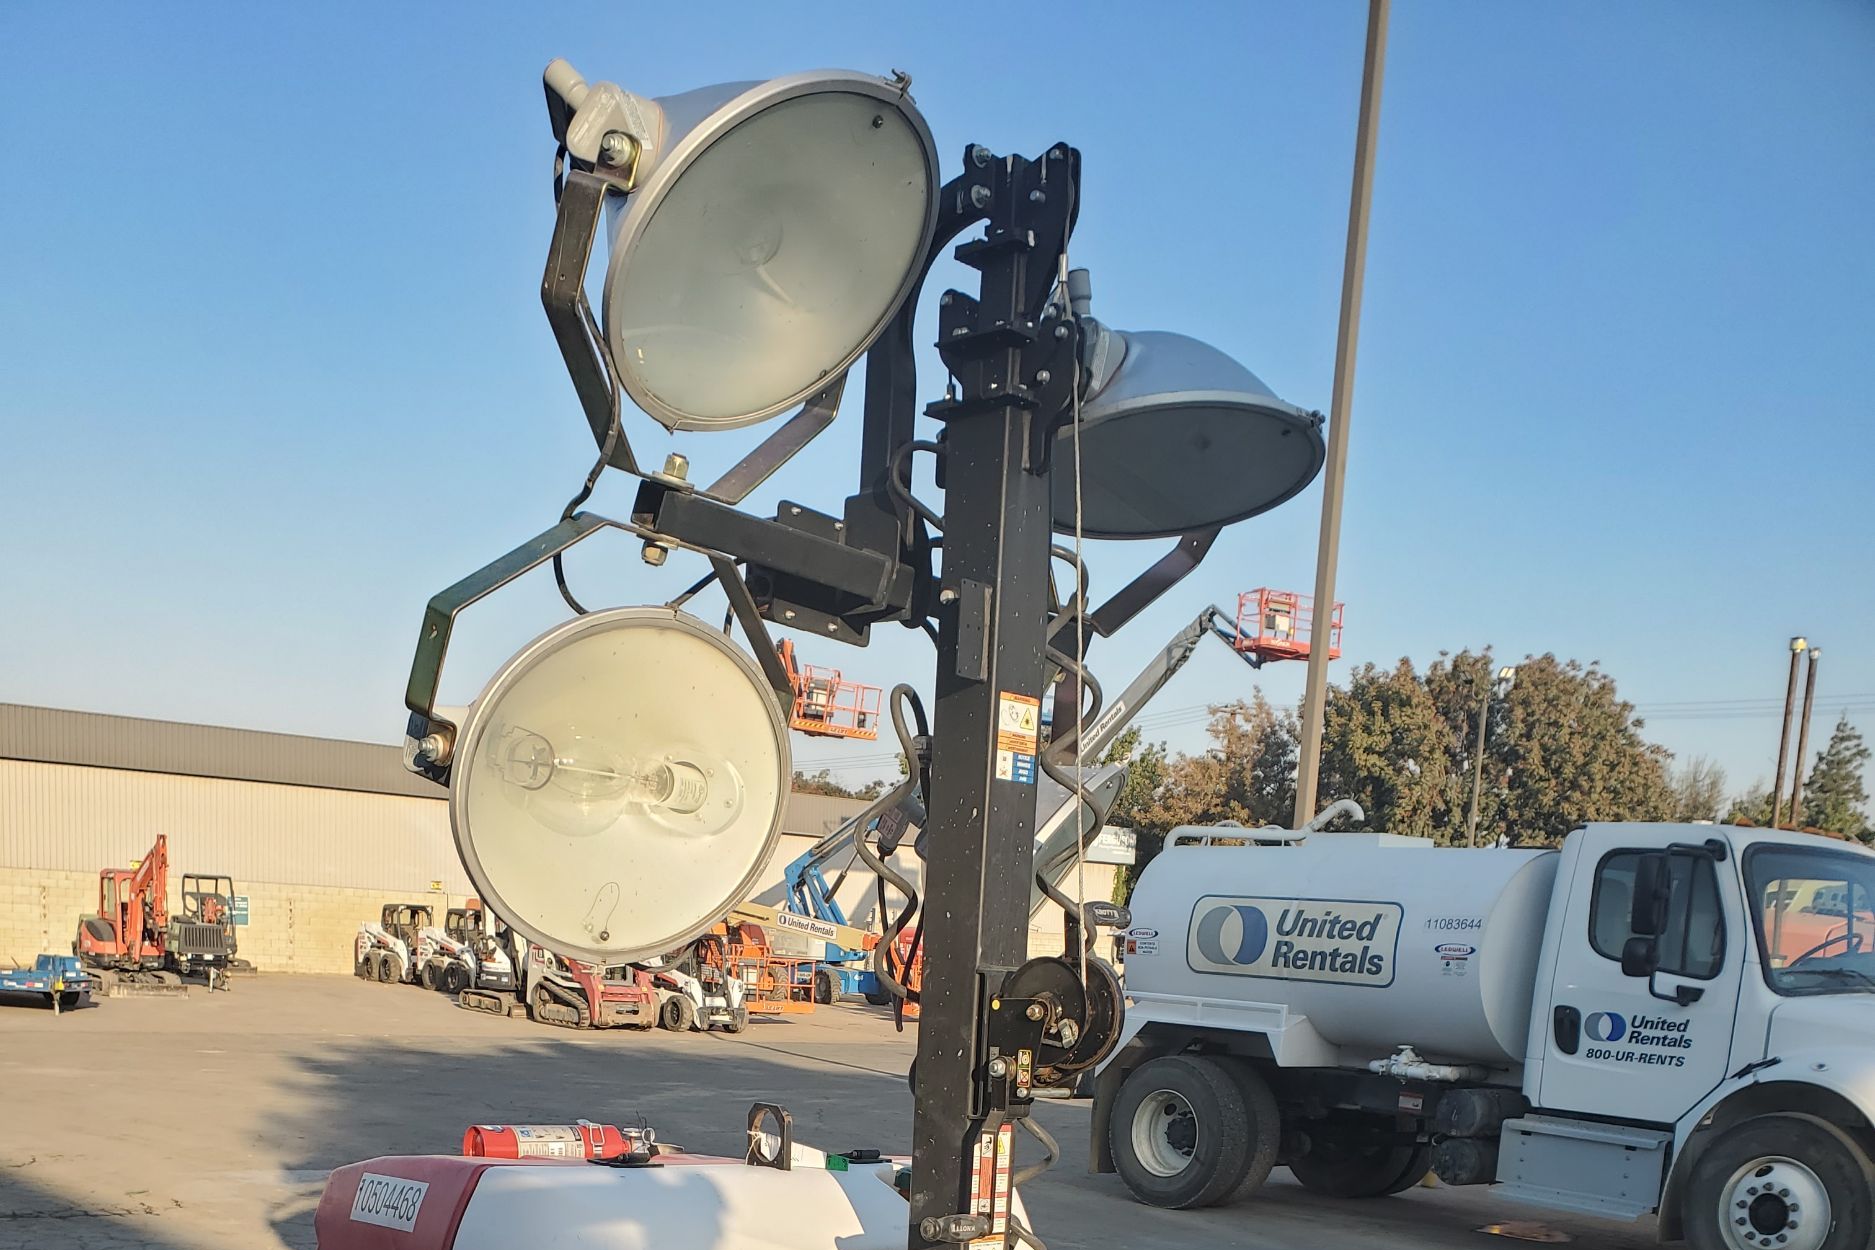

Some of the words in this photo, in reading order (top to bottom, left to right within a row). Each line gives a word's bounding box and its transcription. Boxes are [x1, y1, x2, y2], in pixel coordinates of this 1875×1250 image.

[1100, 706, 1123, 732] Rentals
[787, 917, 810, 930] United
[810, 923, 834, 937] Rentals
[1276, 909, 1383, 941] United
[1427, 918, 1482, 929] 11083644
[1271, 940, 1384, 976] Rentals
[1631, 1015, 1690, 1032] United
[1628, 1031, 1693, 1049] Rentals
[1586, 1048, 1686, 1067] 800-UR-RENTS
[355, 1178, 422, 1221] 10504468
